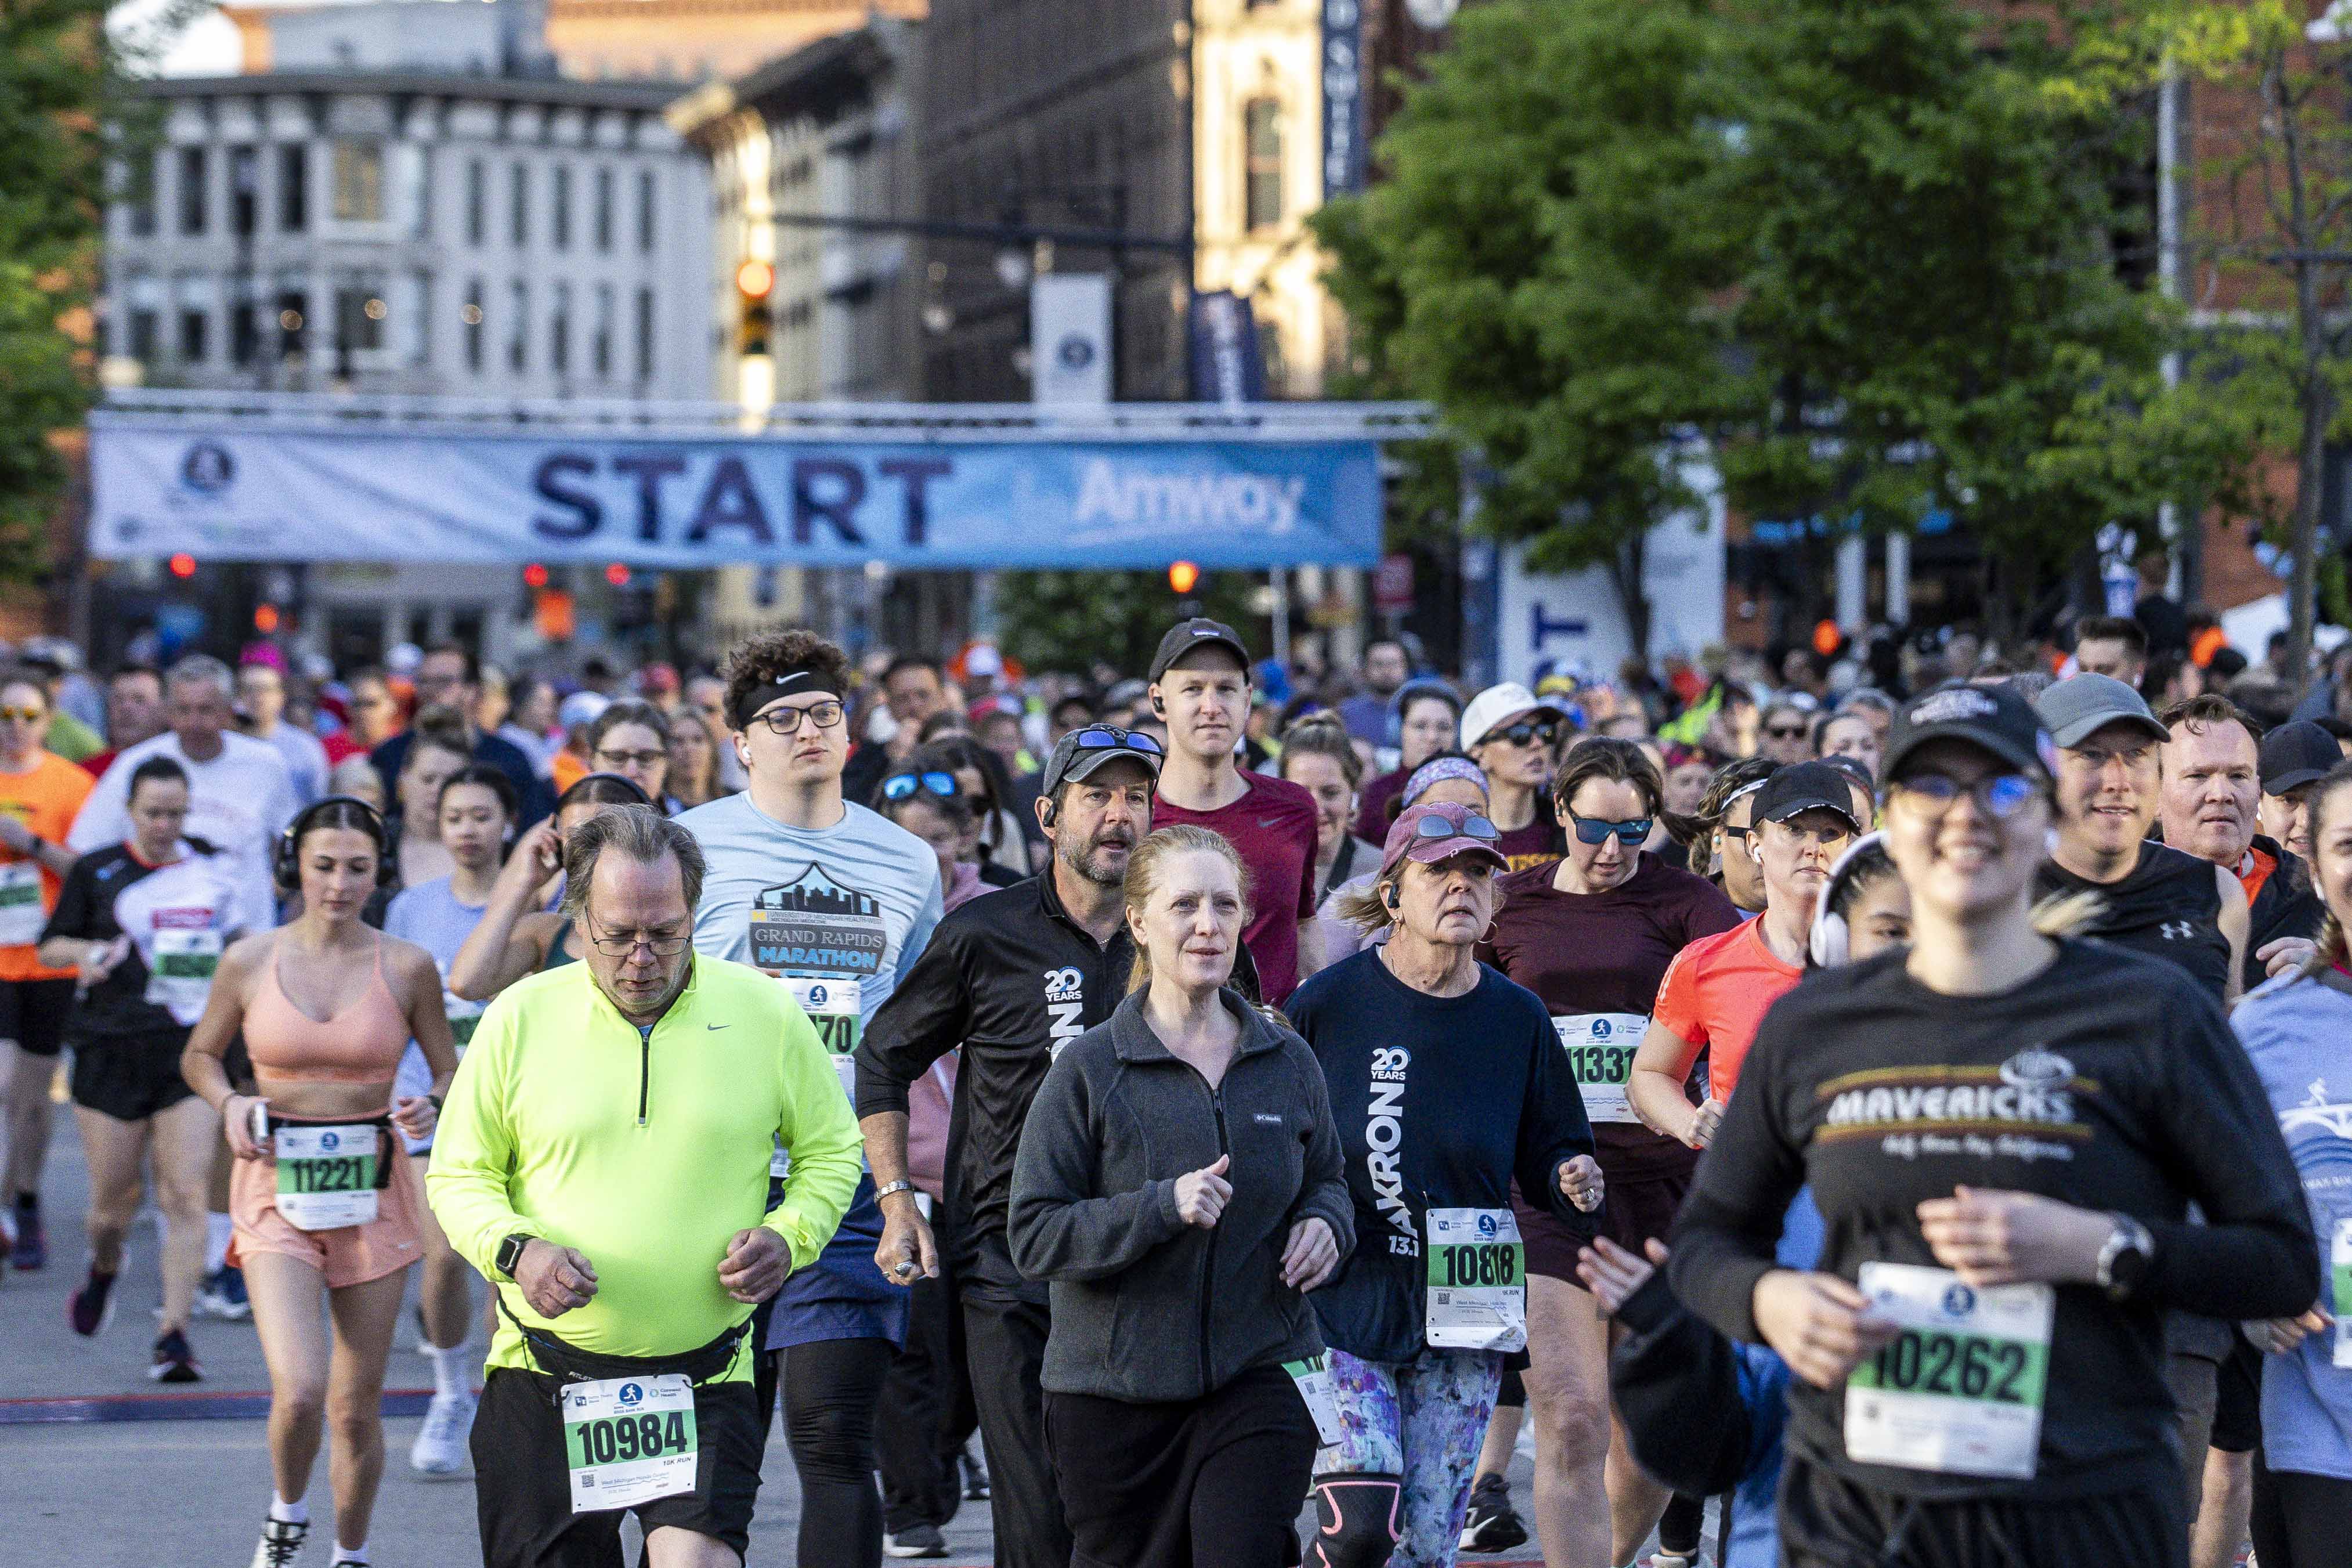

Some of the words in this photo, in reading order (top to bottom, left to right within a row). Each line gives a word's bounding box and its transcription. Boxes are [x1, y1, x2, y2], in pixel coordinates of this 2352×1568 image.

[530, 450, 952, 548] START
[1076, 456, 1304, 534] Amway
[755, 928, 815, 943] GRAND
[822, 931, 883, 948] RAPIDS
[758, 946, 877, 969] MARATHON
[1044, 969, 1082, 993] 20
[1045, 990, 1083, 1002] YEARS
[1371, 1048, 1409, 1071] 20
[1371, 1070, 1406, 1081] YEARS
[1826, 1086, 2076, 1125] MAVERICKS
[292, 1157, 362, 1191] 11221
[1365, 1082, 1418, 1239] AKRON
[1389, 1235, 1419, 1258] 13.1
[1874, 1331, 2026, 1403] 10262
[577, 1411, 687, 1465] 10984
